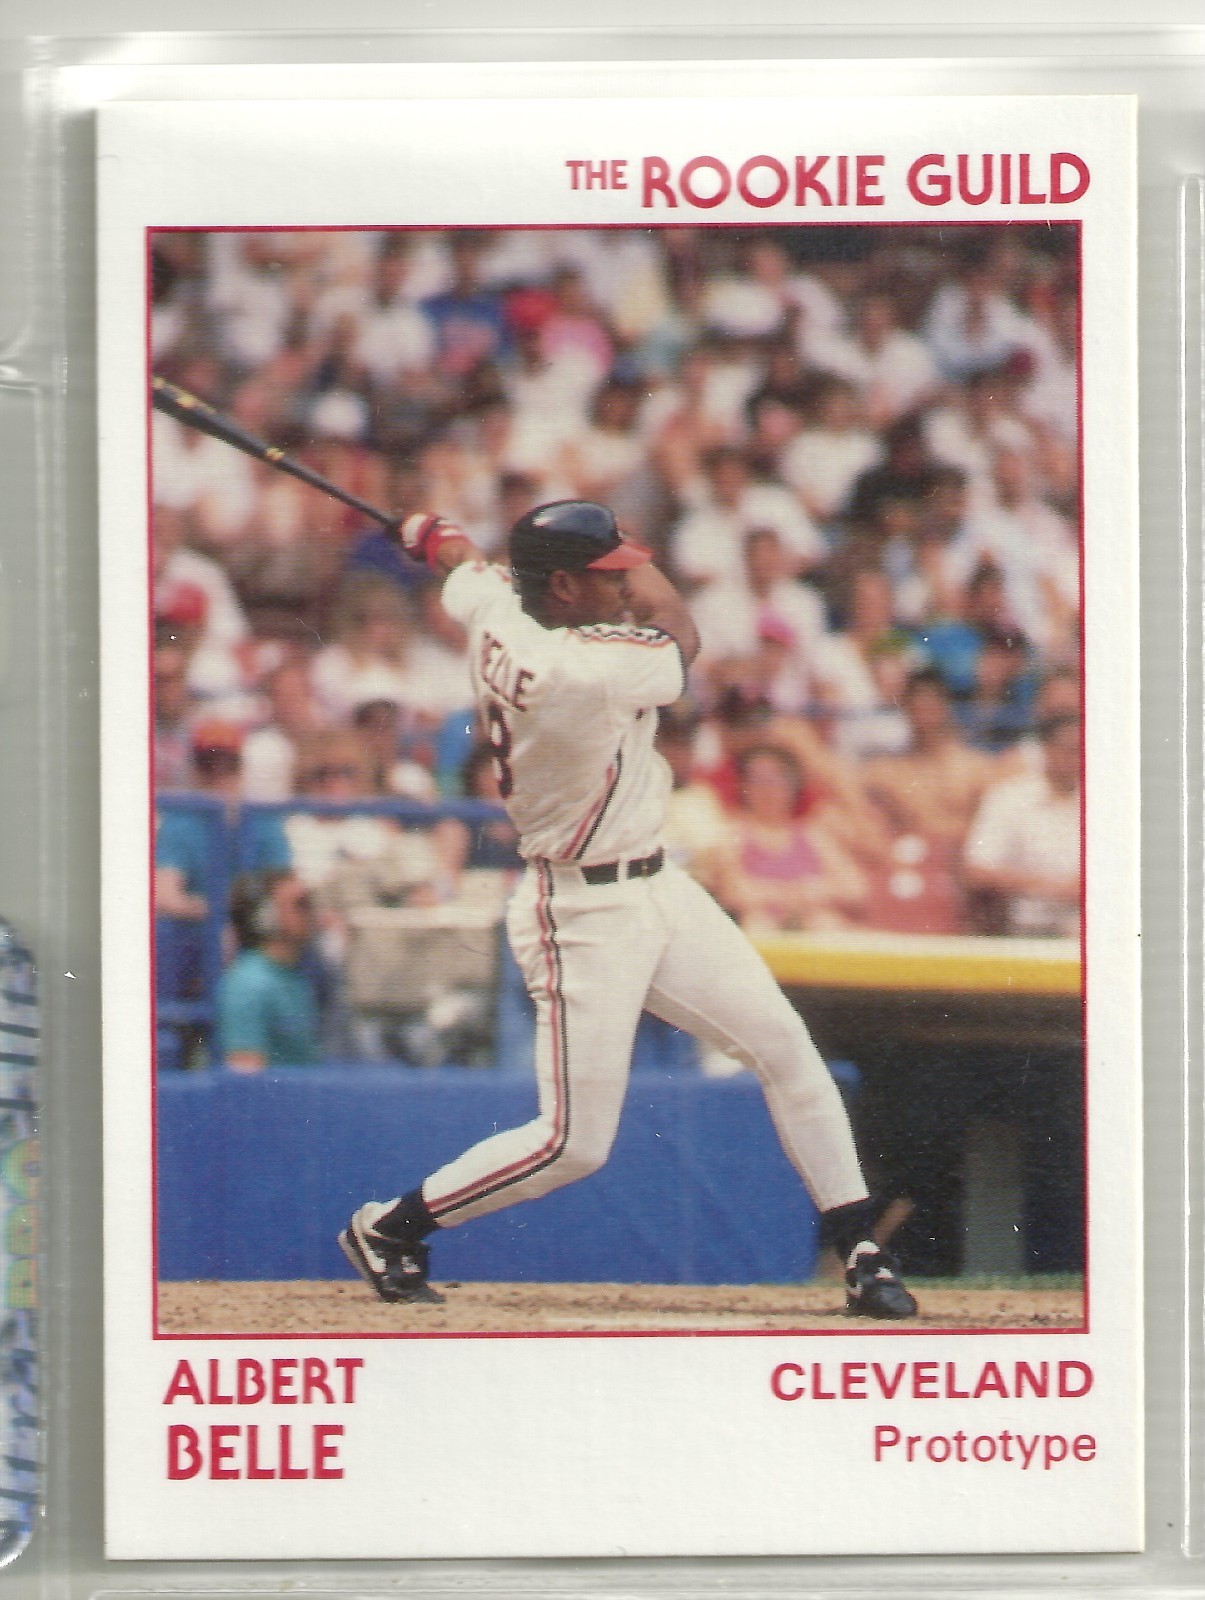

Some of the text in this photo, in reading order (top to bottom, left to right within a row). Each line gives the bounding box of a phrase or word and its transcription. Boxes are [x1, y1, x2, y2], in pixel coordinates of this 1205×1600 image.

[565, 153, 1091, 208] THE ROOKIE GUILD
[164, 1358, 364, 1406] ALBERT
[771, 1360, 1094, 1401] CLEVELAND
[167, 1424, 345, 1481] BELLE
[874, 1426, 1097, 1470] Prototype
